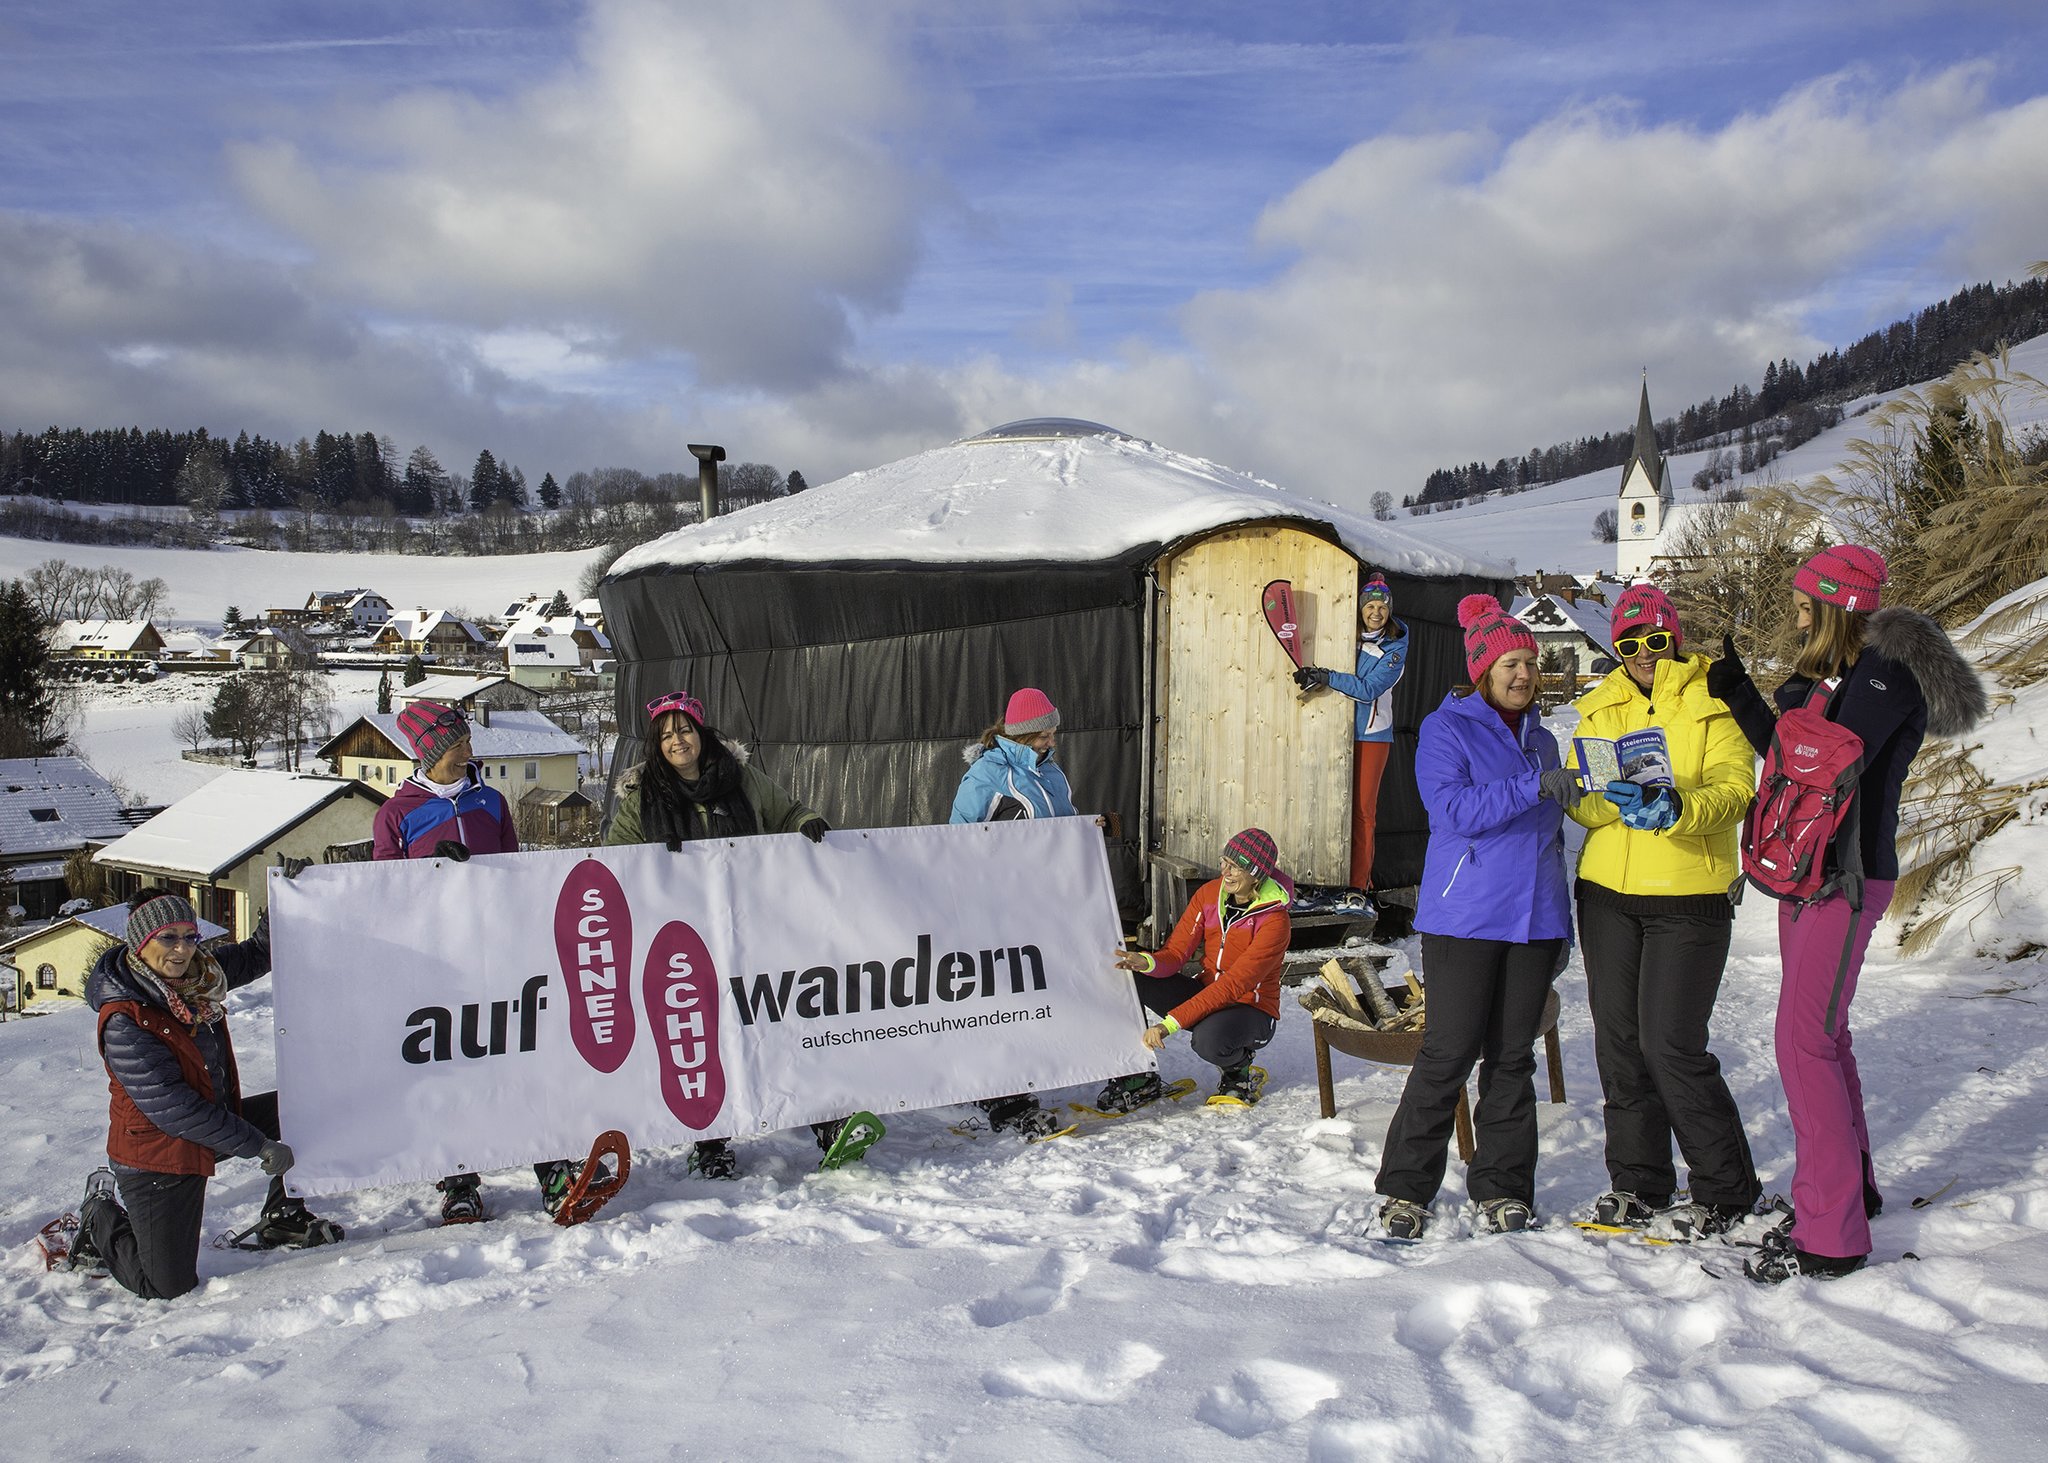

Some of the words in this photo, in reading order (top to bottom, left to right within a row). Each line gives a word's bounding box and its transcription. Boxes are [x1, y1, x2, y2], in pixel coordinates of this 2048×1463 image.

[1621, 735, 1661, 749] Steiermark
[401, 974, 549, 1065] auf
[576, 888, 617, 1045] SCHNEE
[664, 952, 707, 1100] SCHUH
[729, 933, 1047, 1026] wandern
[801, 1004, 1053, 1050] aufschneeschuhwandern.at
